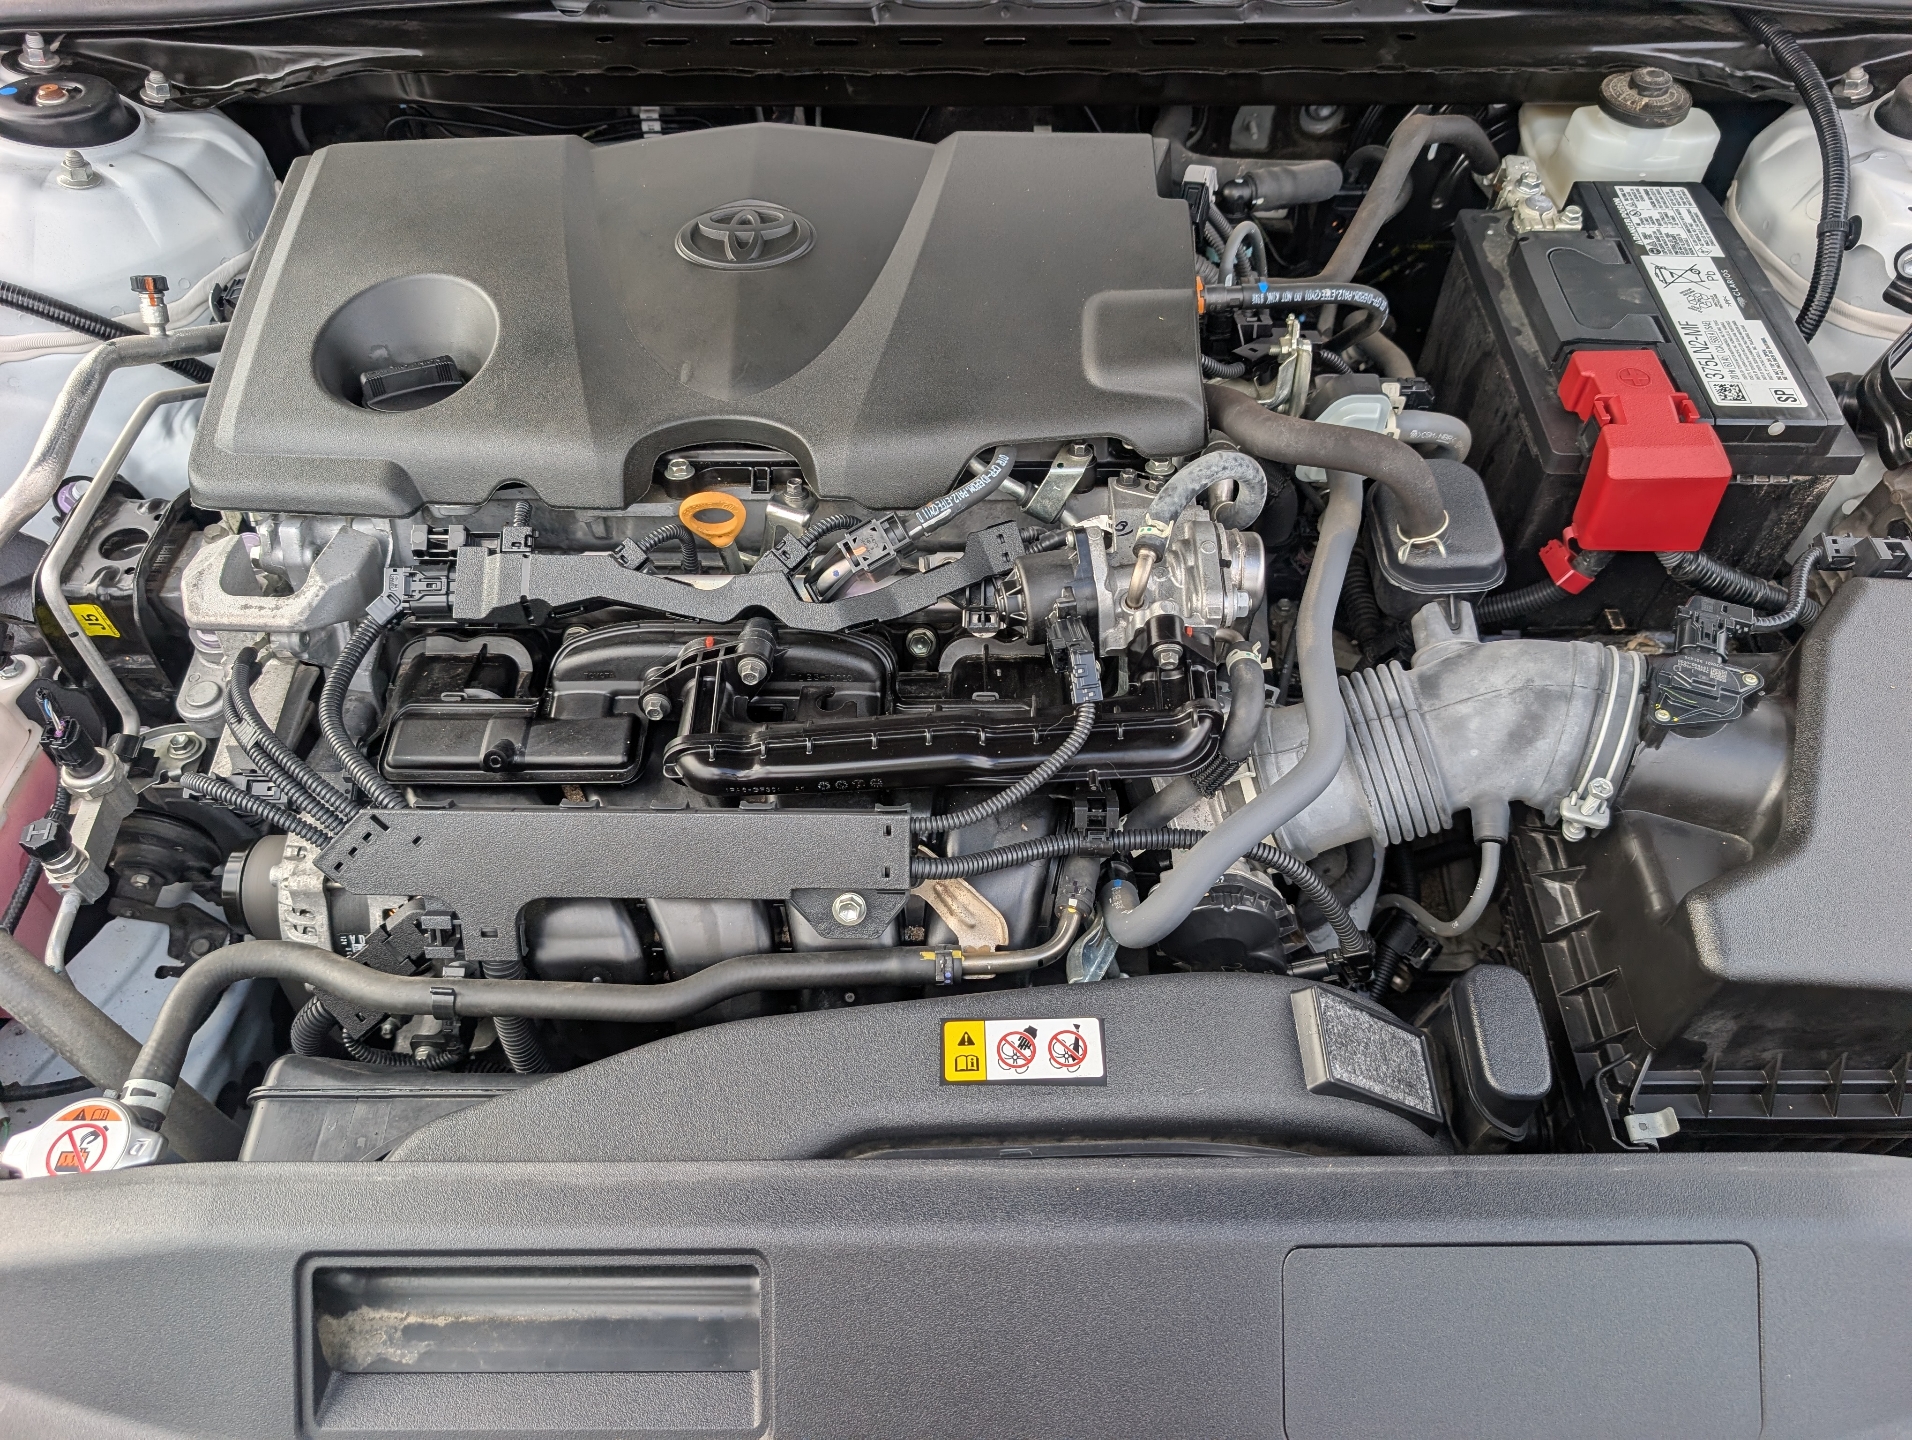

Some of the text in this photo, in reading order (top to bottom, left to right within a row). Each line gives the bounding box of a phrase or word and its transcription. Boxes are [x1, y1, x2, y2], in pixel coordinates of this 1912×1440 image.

[1705, 270, 1719, 282] Pb
[1720, 269, 1741, 298] CLARIOS
[1678, 320, 1724, 380] 375LN2-MF
[1773, 389, 1798, 403] SP
[81, 613, 107, 631] J5
[26, 822, 52, 842] H
